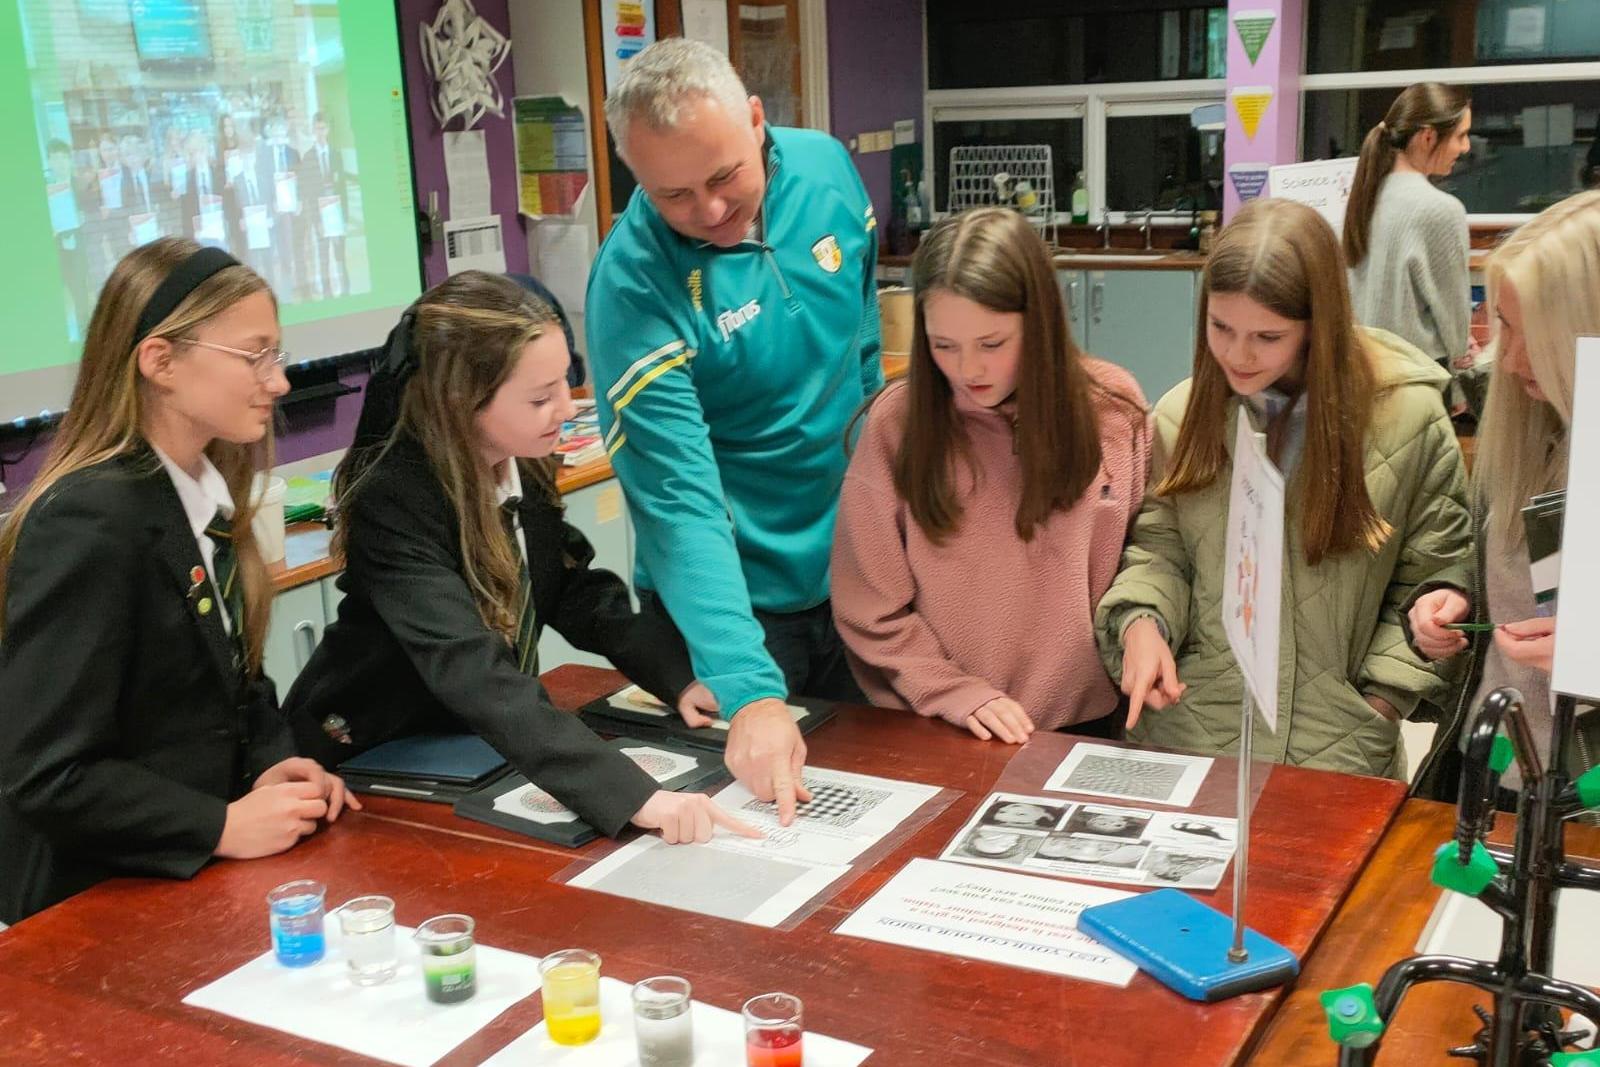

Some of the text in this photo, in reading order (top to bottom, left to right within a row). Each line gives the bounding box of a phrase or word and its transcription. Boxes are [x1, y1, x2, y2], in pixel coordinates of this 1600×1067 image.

[954, 882, 994, 892] they?
[960, 891, 987, 899] you
[1018, 893, 1065, 904] colour
[1016, 901, 1079, 915] numbers
[966, 916, 1030, 931] designed
[877, 917, 1110, 963] TEST YOUR COLOUR VISION
